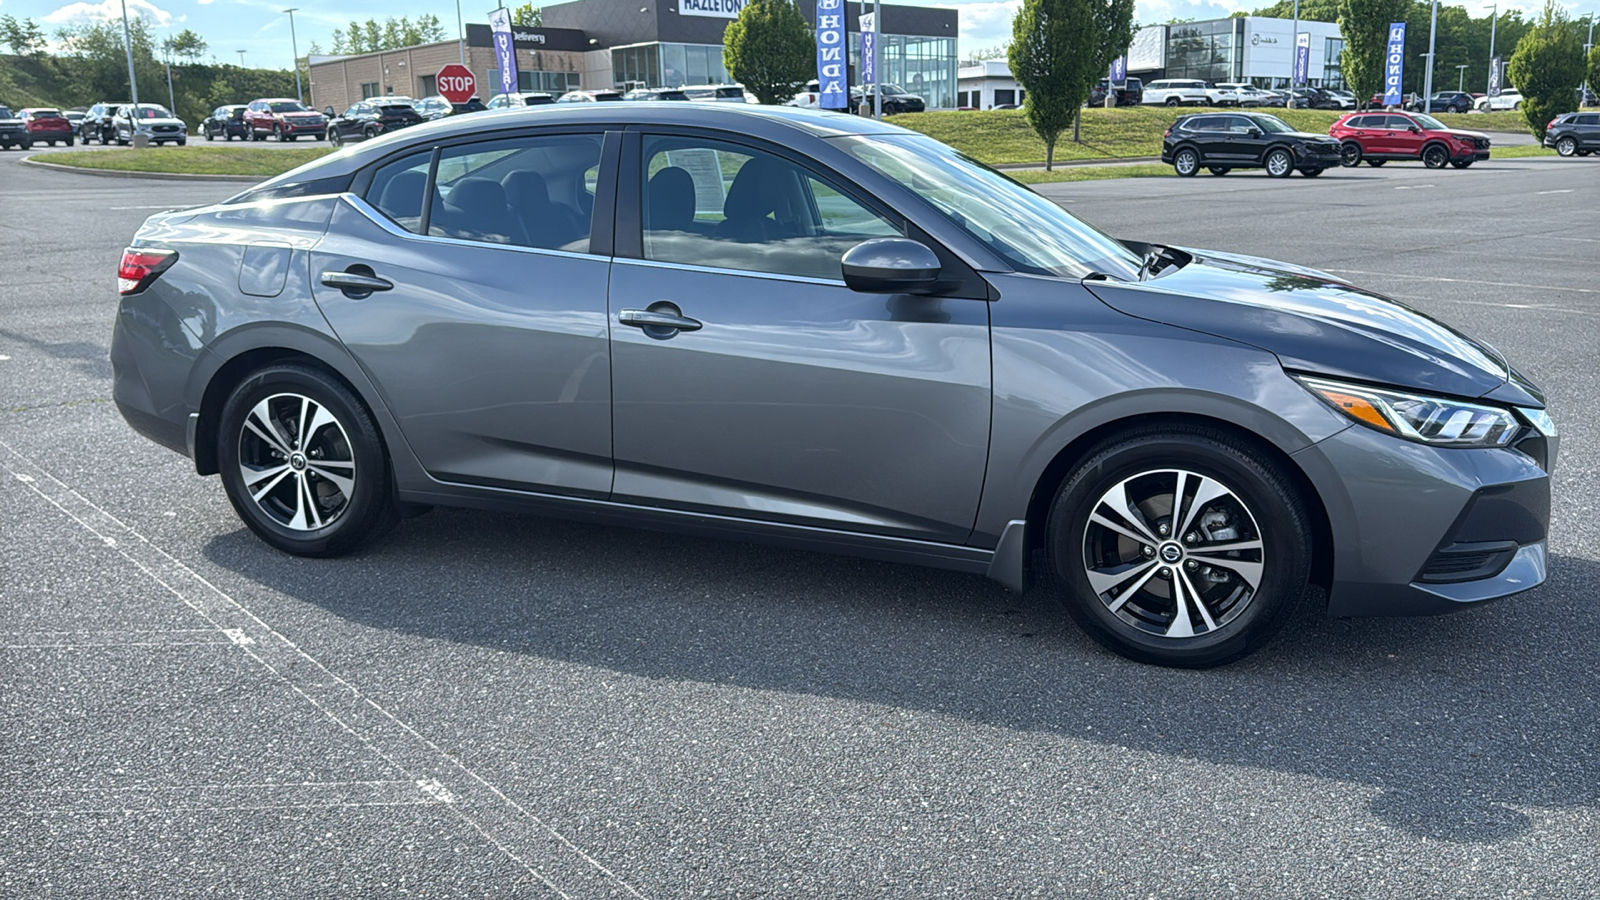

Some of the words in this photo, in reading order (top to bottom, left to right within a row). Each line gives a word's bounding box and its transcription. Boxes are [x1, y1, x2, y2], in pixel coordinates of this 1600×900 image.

[684, 0, 742, 15] HAZLETON
[497, 34, 512, 92] HYUNDAI
[439, 76, 473, 92] STOP
